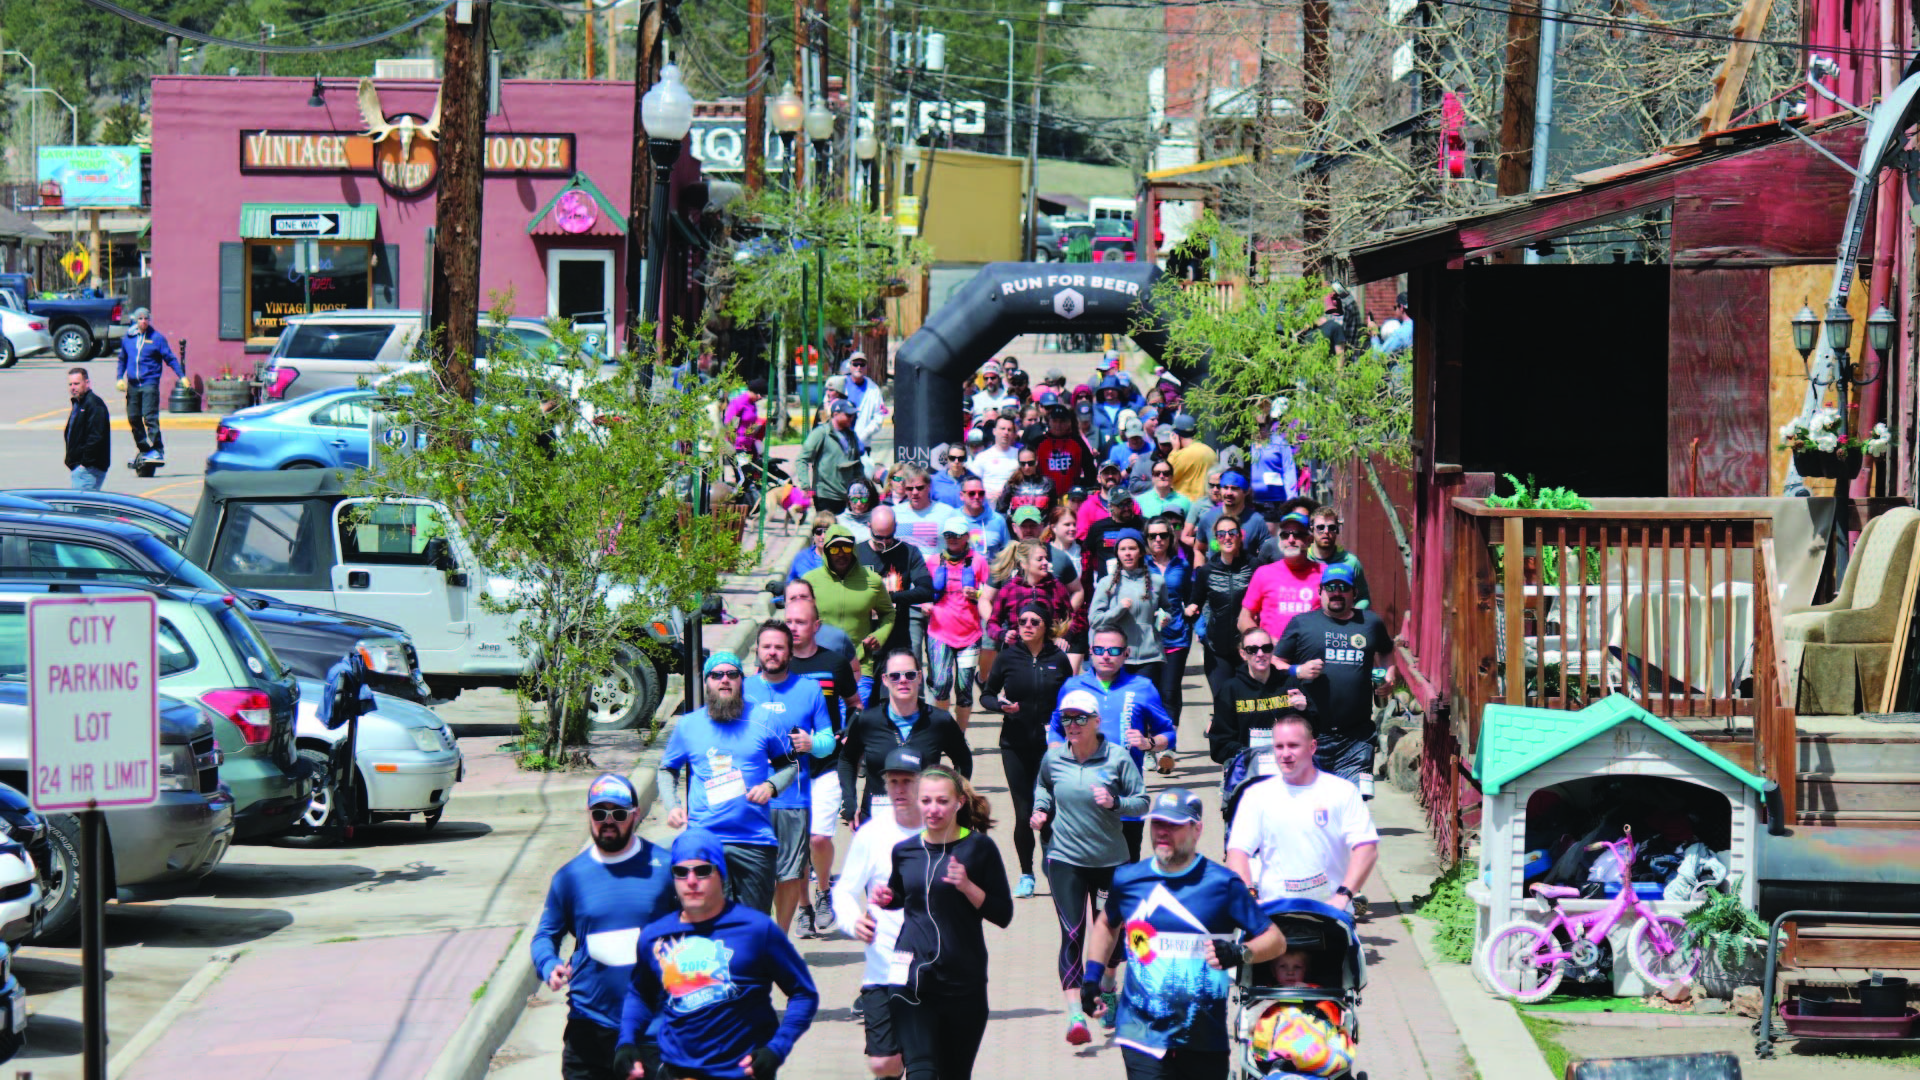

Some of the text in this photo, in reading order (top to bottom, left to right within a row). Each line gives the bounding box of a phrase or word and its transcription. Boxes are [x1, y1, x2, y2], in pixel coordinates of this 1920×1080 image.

[40, 149, 103, 159] CATCH WILD
[249, 132, 349, 167] VINTAGE
[484, 136, 562, 169] OOSE
[70, 159, 108, 170] TROUT
[382, 161, 429, 187] TAVERN
[278, 220, 320, 230] ONE WAY
[1001, 274, 1140, 297] RUN FOR BEER
[898, 445, 930, 461] RUN
[1048, 457, 1072, 471] BEEF
[1279, 601, 1312, 613] BEER
[68, 615, 115, 645] CITY
[1325, 631, 1348, 641] RUN
[478, 642, 501, 652] Jeep
[1325, 639, 1348, 649] FOR
[1325, 648, 1365, 662] BEER
[48, 661, 139, 694] PARKING
[74, 712, 112, 742] LOT
[39, 759, 149, 795] 24 HR LIMIT
[681, 960, 708, 972] 2019
